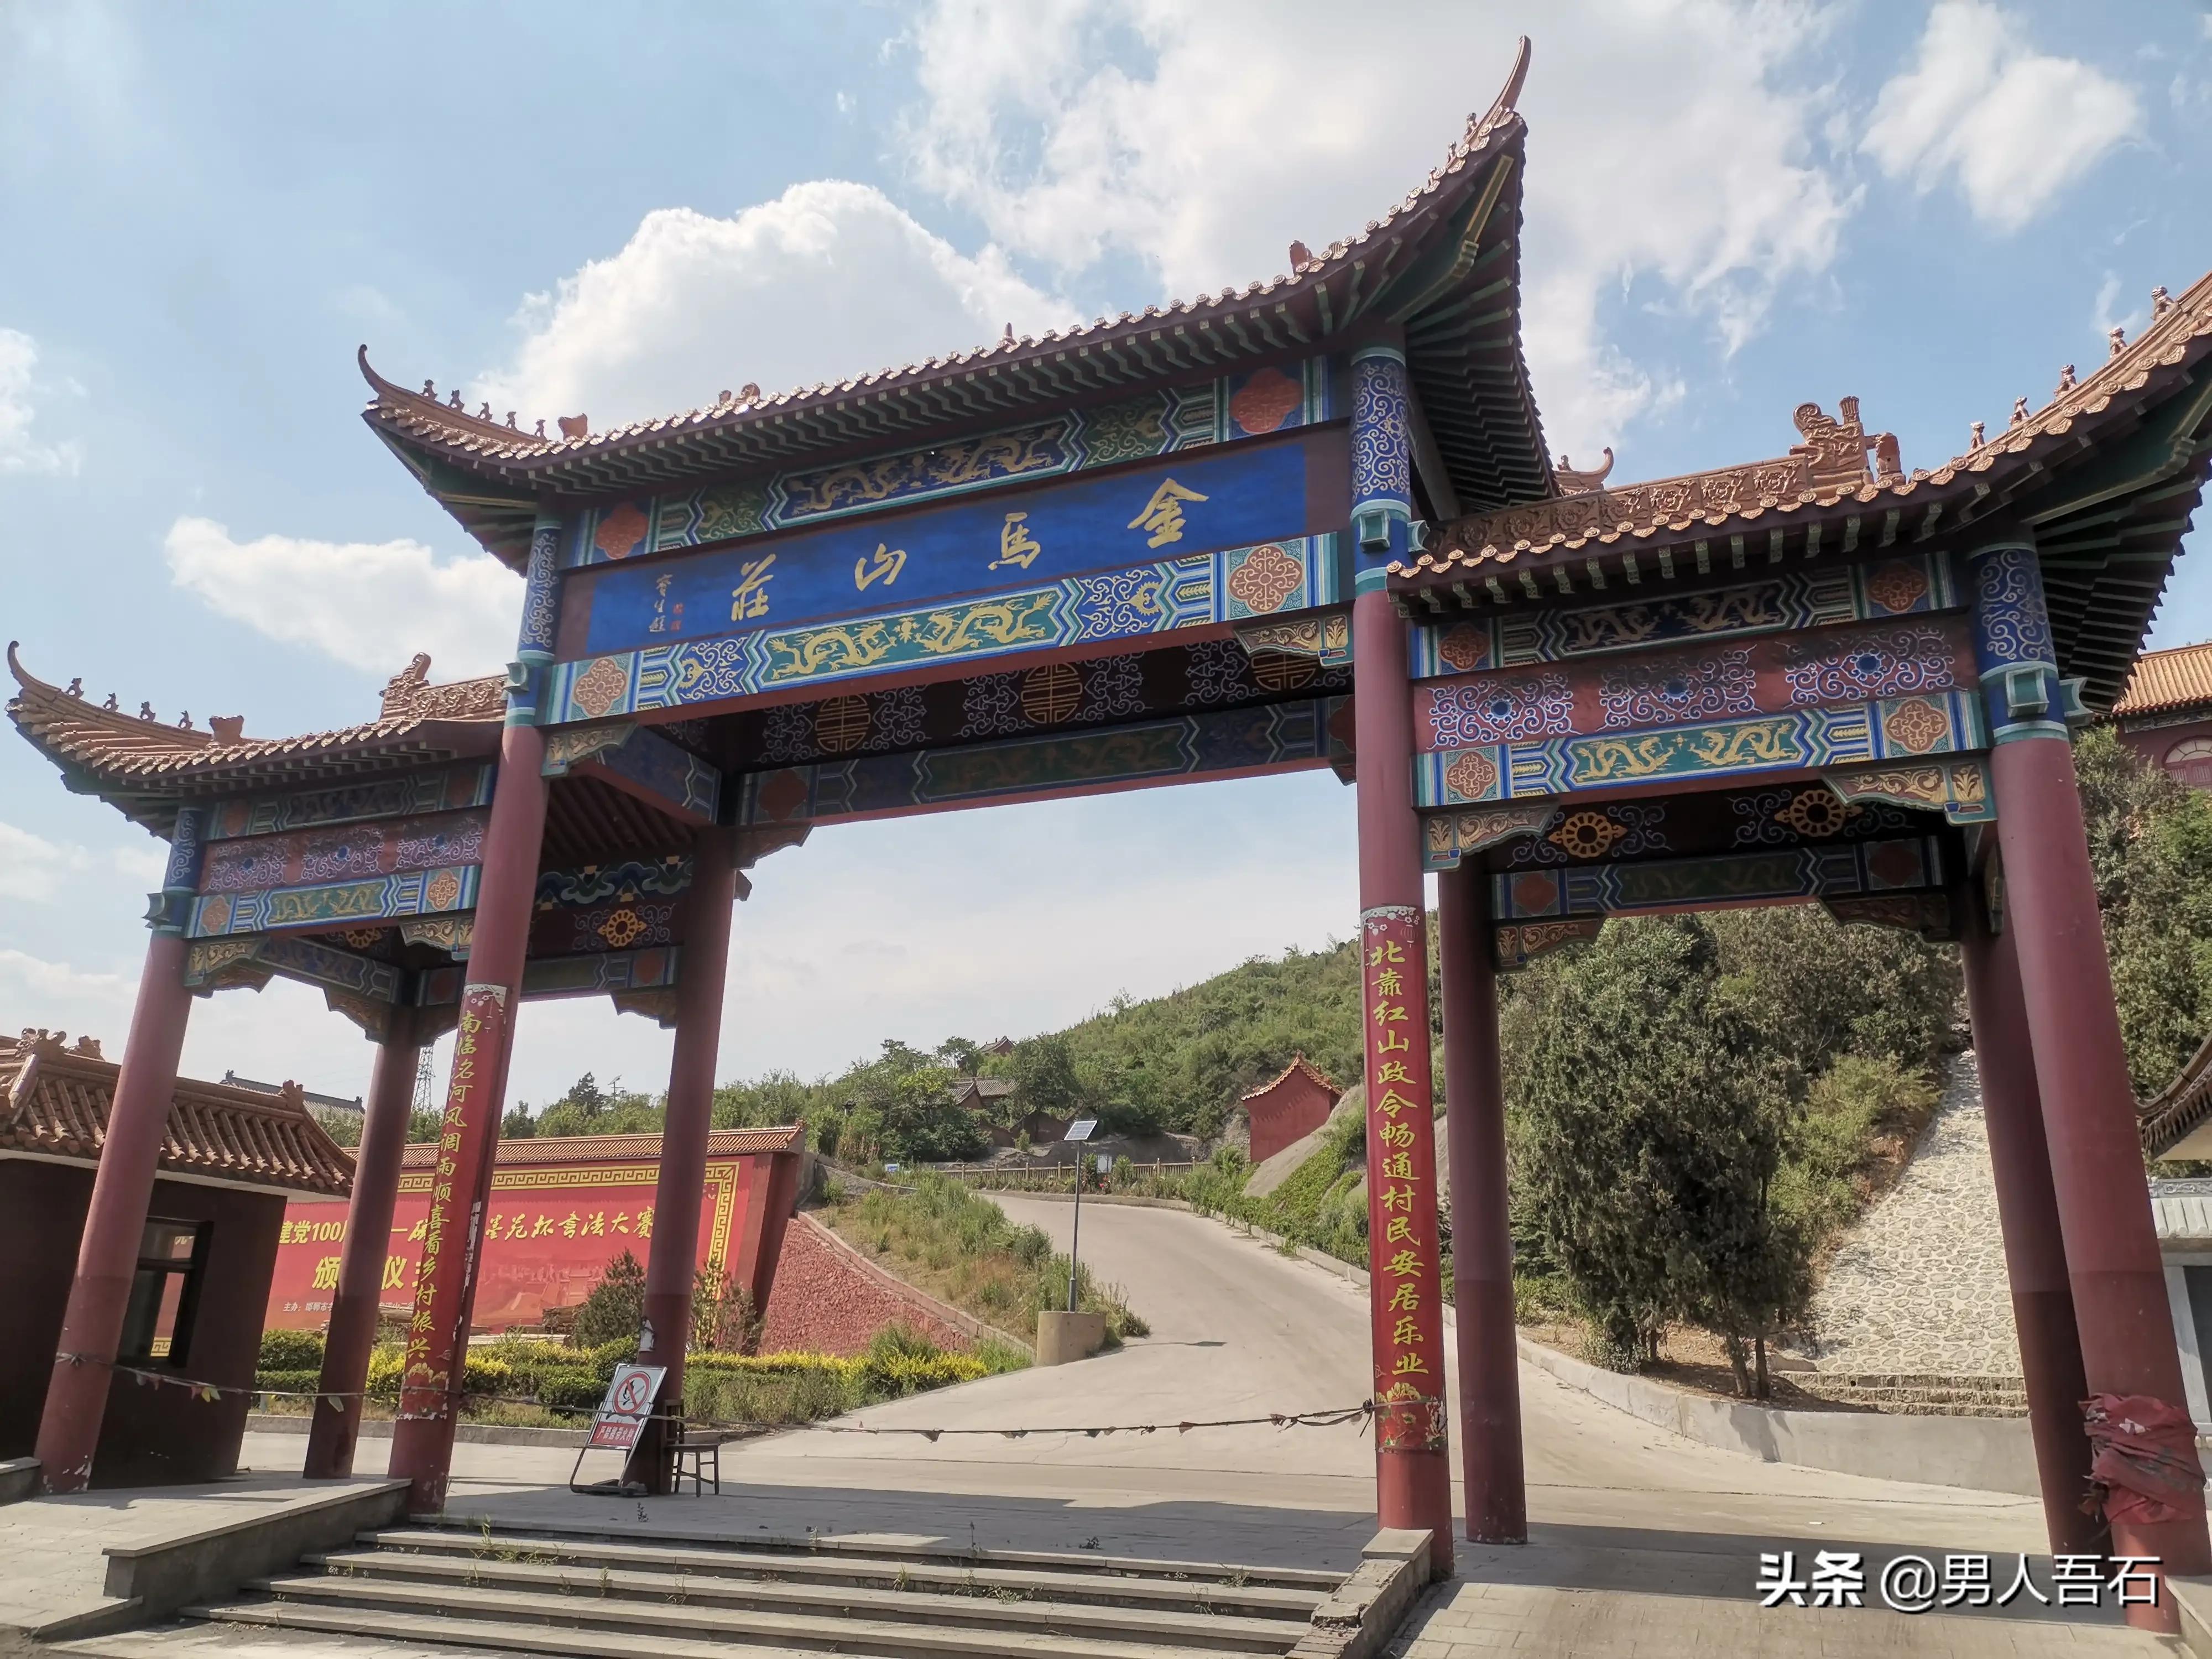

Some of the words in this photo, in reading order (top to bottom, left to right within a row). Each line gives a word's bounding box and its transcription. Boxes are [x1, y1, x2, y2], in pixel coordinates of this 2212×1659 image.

[1370, 940, 1429, 1376] 北靠红山政令畅通村民安居乐业
